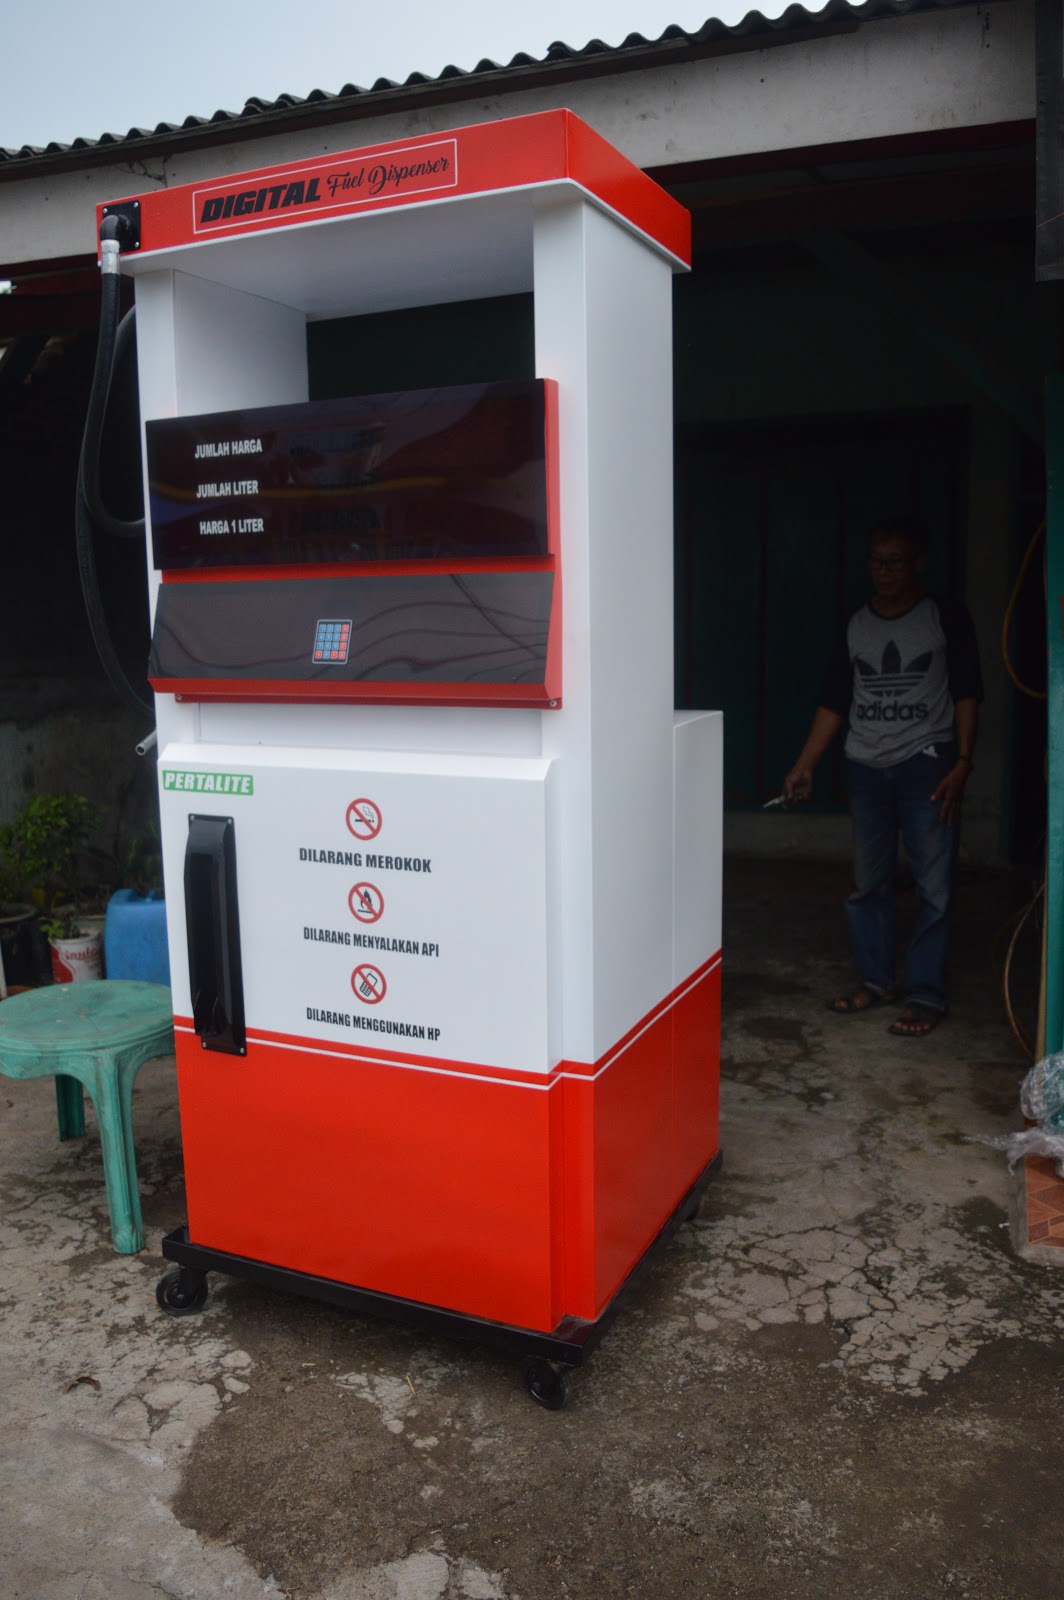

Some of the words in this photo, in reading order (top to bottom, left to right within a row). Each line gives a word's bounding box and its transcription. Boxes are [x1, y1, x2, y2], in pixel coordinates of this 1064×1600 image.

[200, 177, 321, 224] DIGITAL
[326, 167, 366, 198] Fuel
[367, 157, 449, 196] Dispenser
[195, 442, 229, 458] JUMLAH
[232, 439, 262, 455] HARGA
[197, 482, 231, 498] JUMLAH
[233, 480, 259, 496] LITER
[199, 520, 230, 535] HARGA
[231, 519, 237, 534] 1
[238, 518, 264, 534] LITER
[857, 700, 929, 721] adidas
[164, 772, 251, 793] PERTALITE
[299, 847, 362, 867] DILARANG
[365, 854, 432, 873] MEROKOK
[303, 926, 351, 946] DILARANG
[353, 933, 420, 955] MENYALAKAN
[421, 942, 439, 957] API
[306, 1007, 351, 1027] DILARANG
[353, 1015, 425, 1039] MENGGUNAKAN
[427, 1027, 441, 1041] HP
